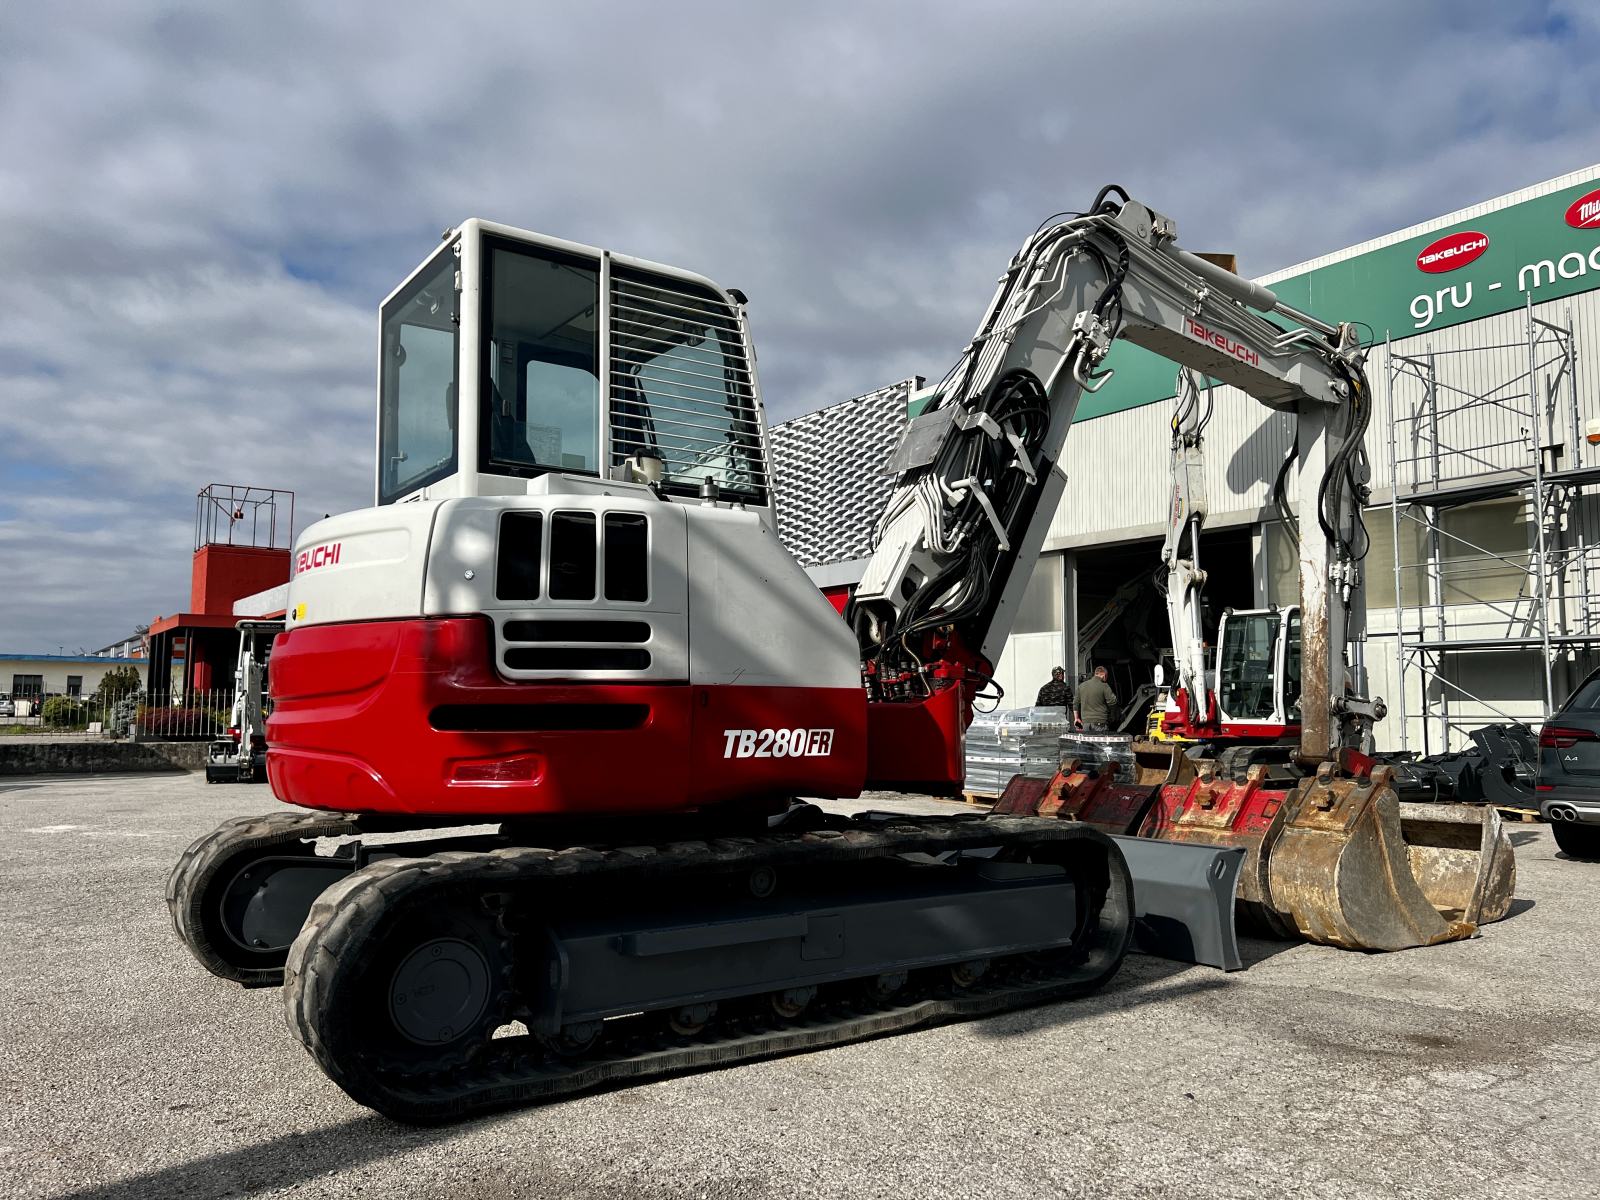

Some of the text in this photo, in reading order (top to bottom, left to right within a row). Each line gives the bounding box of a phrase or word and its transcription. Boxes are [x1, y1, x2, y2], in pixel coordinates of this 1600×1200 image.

[1418, 238, 1487, 265] TAKEUCHI
[1409, 281, 1473, 329] gru
[1186, 318, 1259, 366] TAKEUCHI
